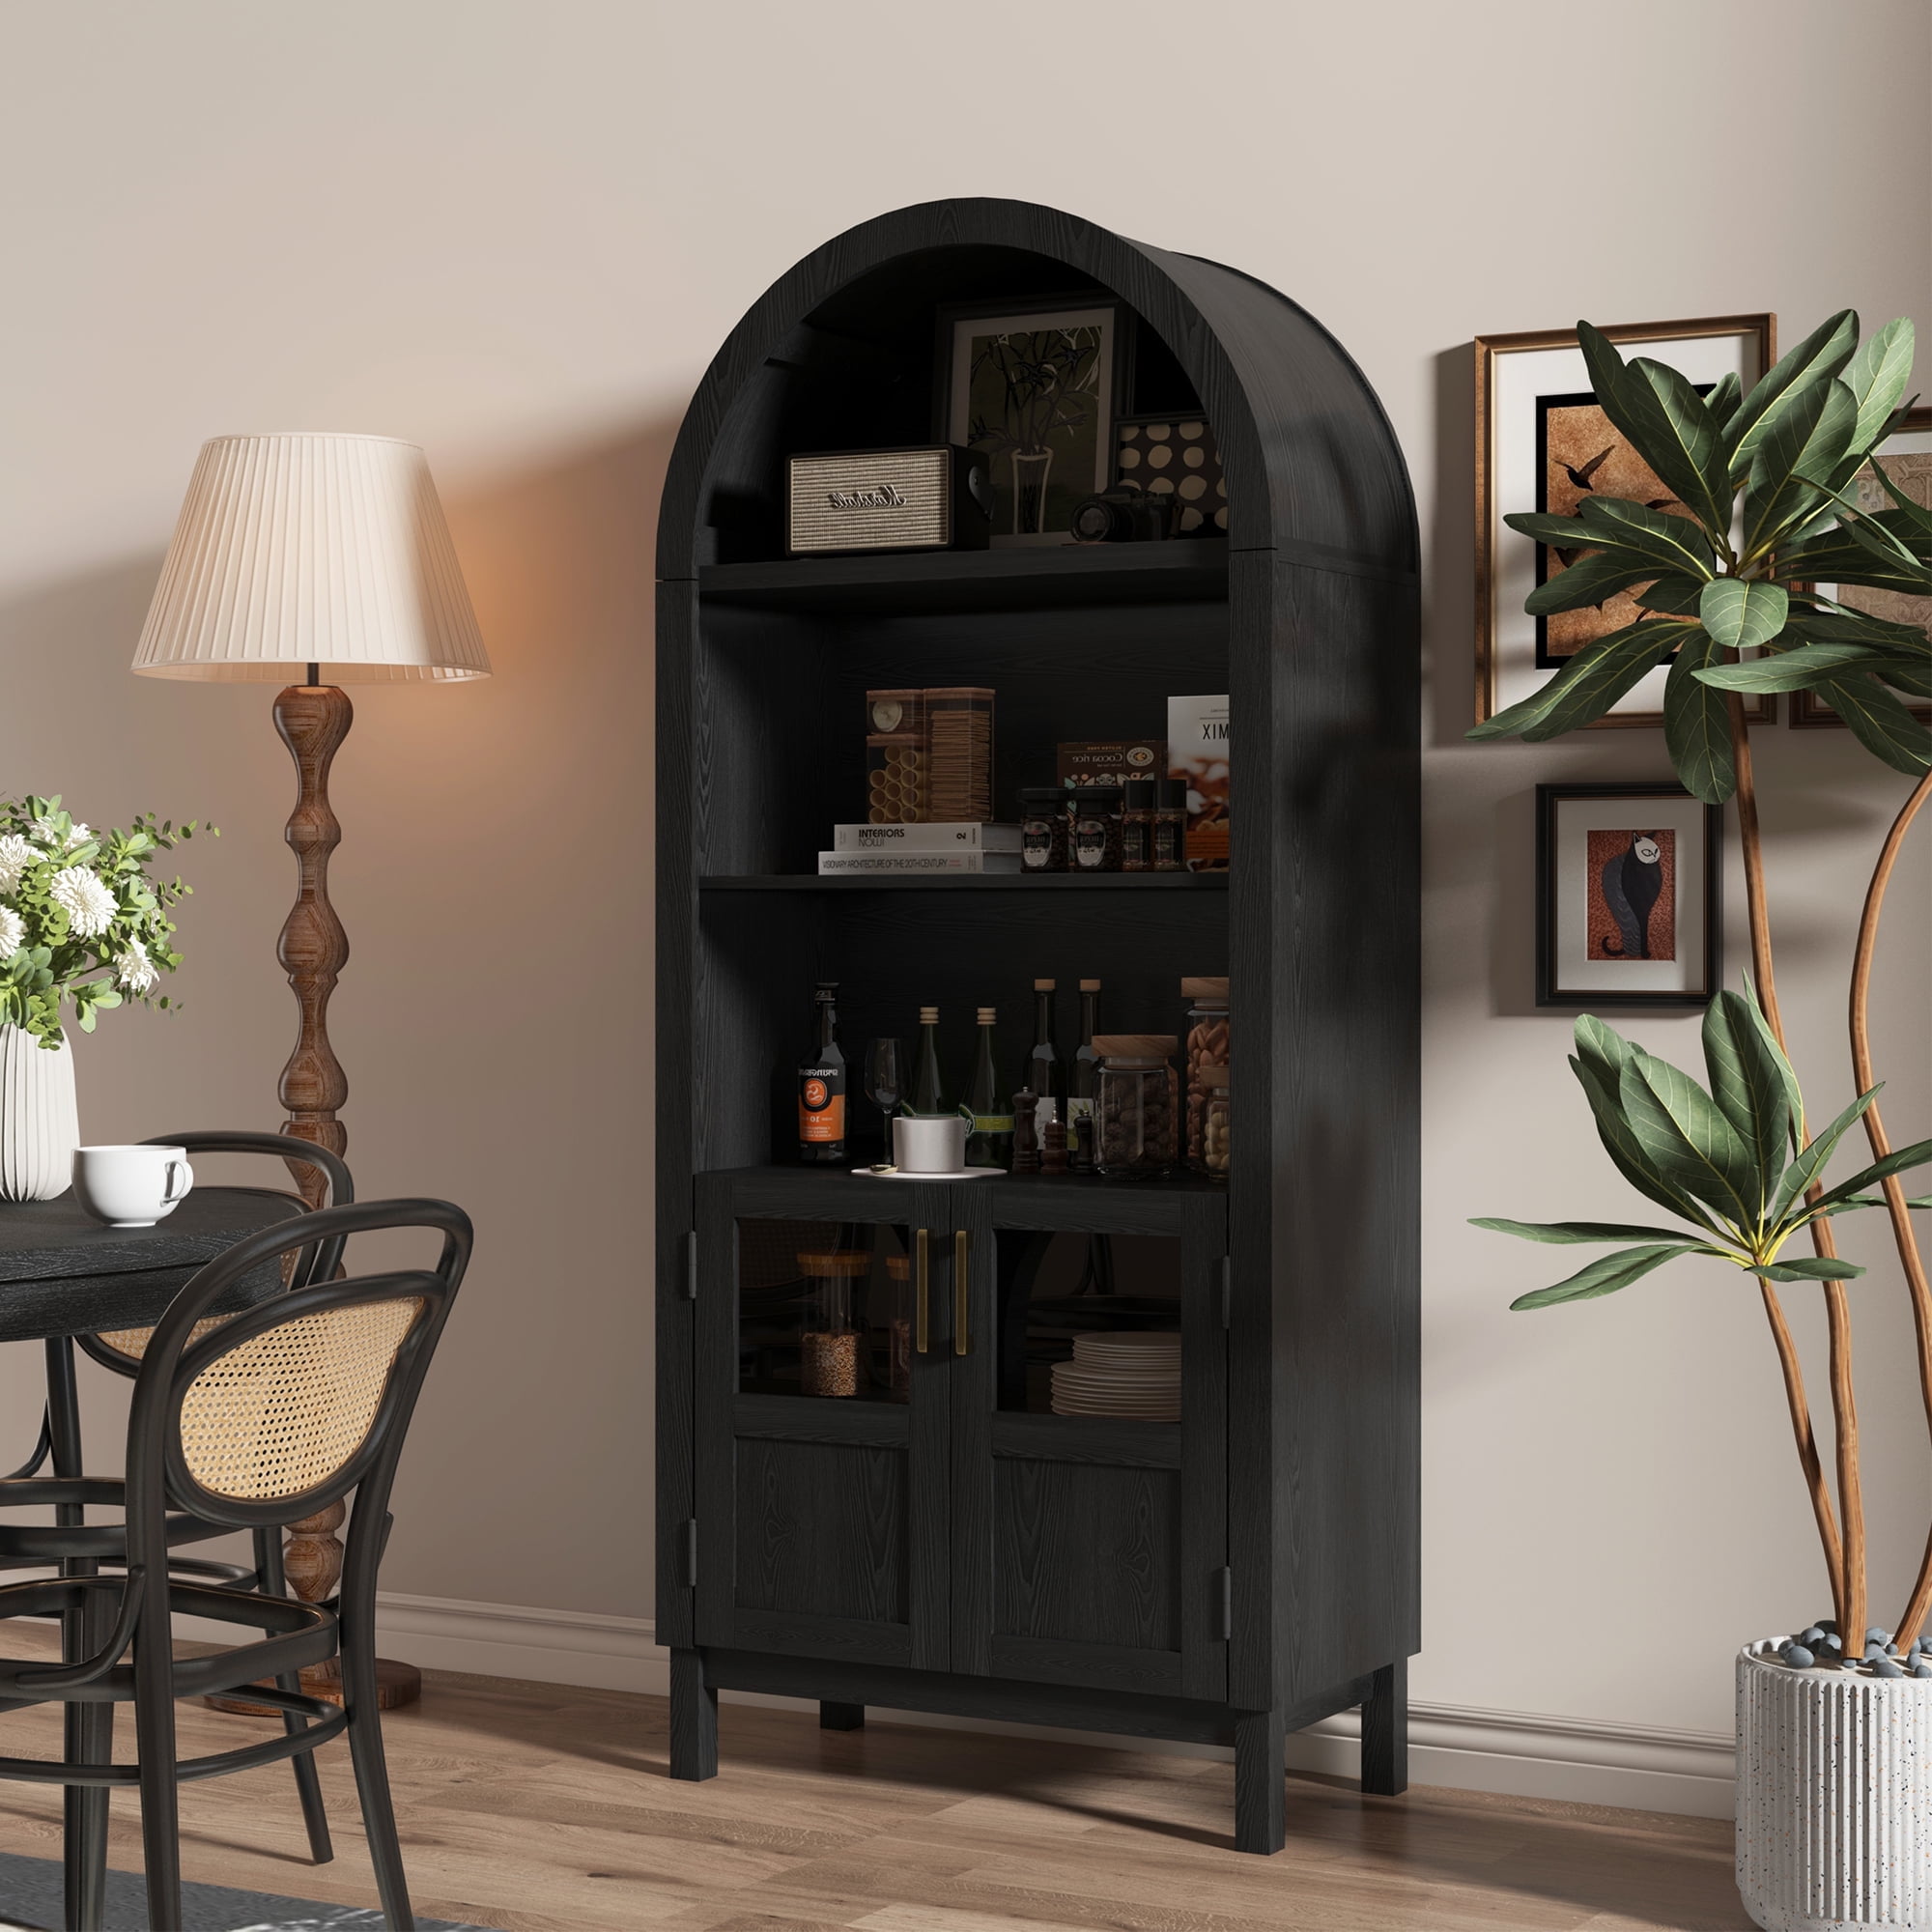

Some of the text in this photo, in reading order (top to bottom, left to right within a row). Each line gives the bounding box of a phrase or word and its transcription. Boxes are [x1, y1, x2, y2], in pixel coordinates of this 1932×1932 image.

[859, 829, 905, 838] INTERIORS
[822, 860, 847, 868] VISIONARY
[848, 860, 886, 868] ARCHITECTURE
[895, 859, 904, 867] THE
[921, 859, 948, 867] CENTURY
